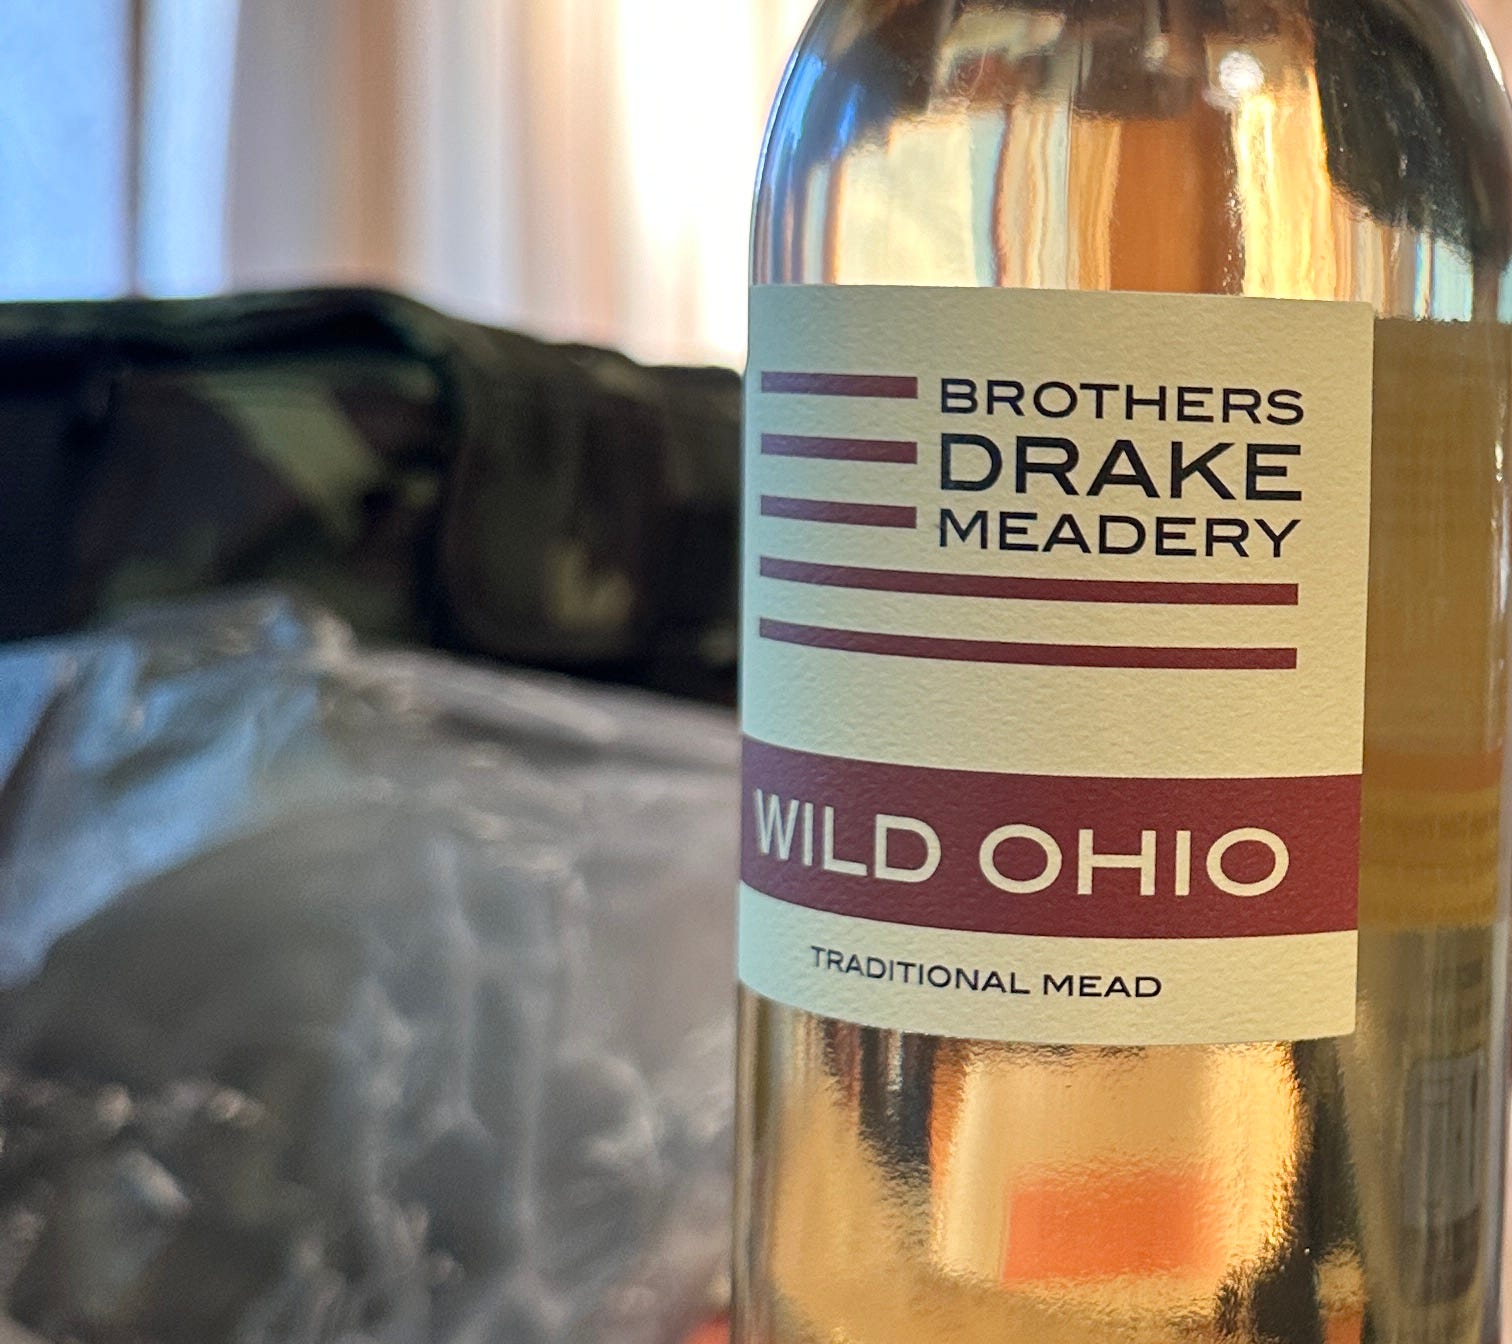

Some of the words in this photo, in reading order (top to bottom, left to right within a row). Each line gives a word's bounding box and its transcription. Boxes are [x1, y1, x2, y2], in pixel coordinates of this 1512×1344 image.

[940, 377, 1304, 426] BROTHERS
[940, 433, 1302, 502] DRAKE
[939, 508, 1301, 558] MEADERY
[753, 787, 943, 885] WILD
[978, 823, 1290, 897] OHIO
[810, 945, 1030, 996] TRADITIONAL
[1042, 973, 1163, 998] MEAD
